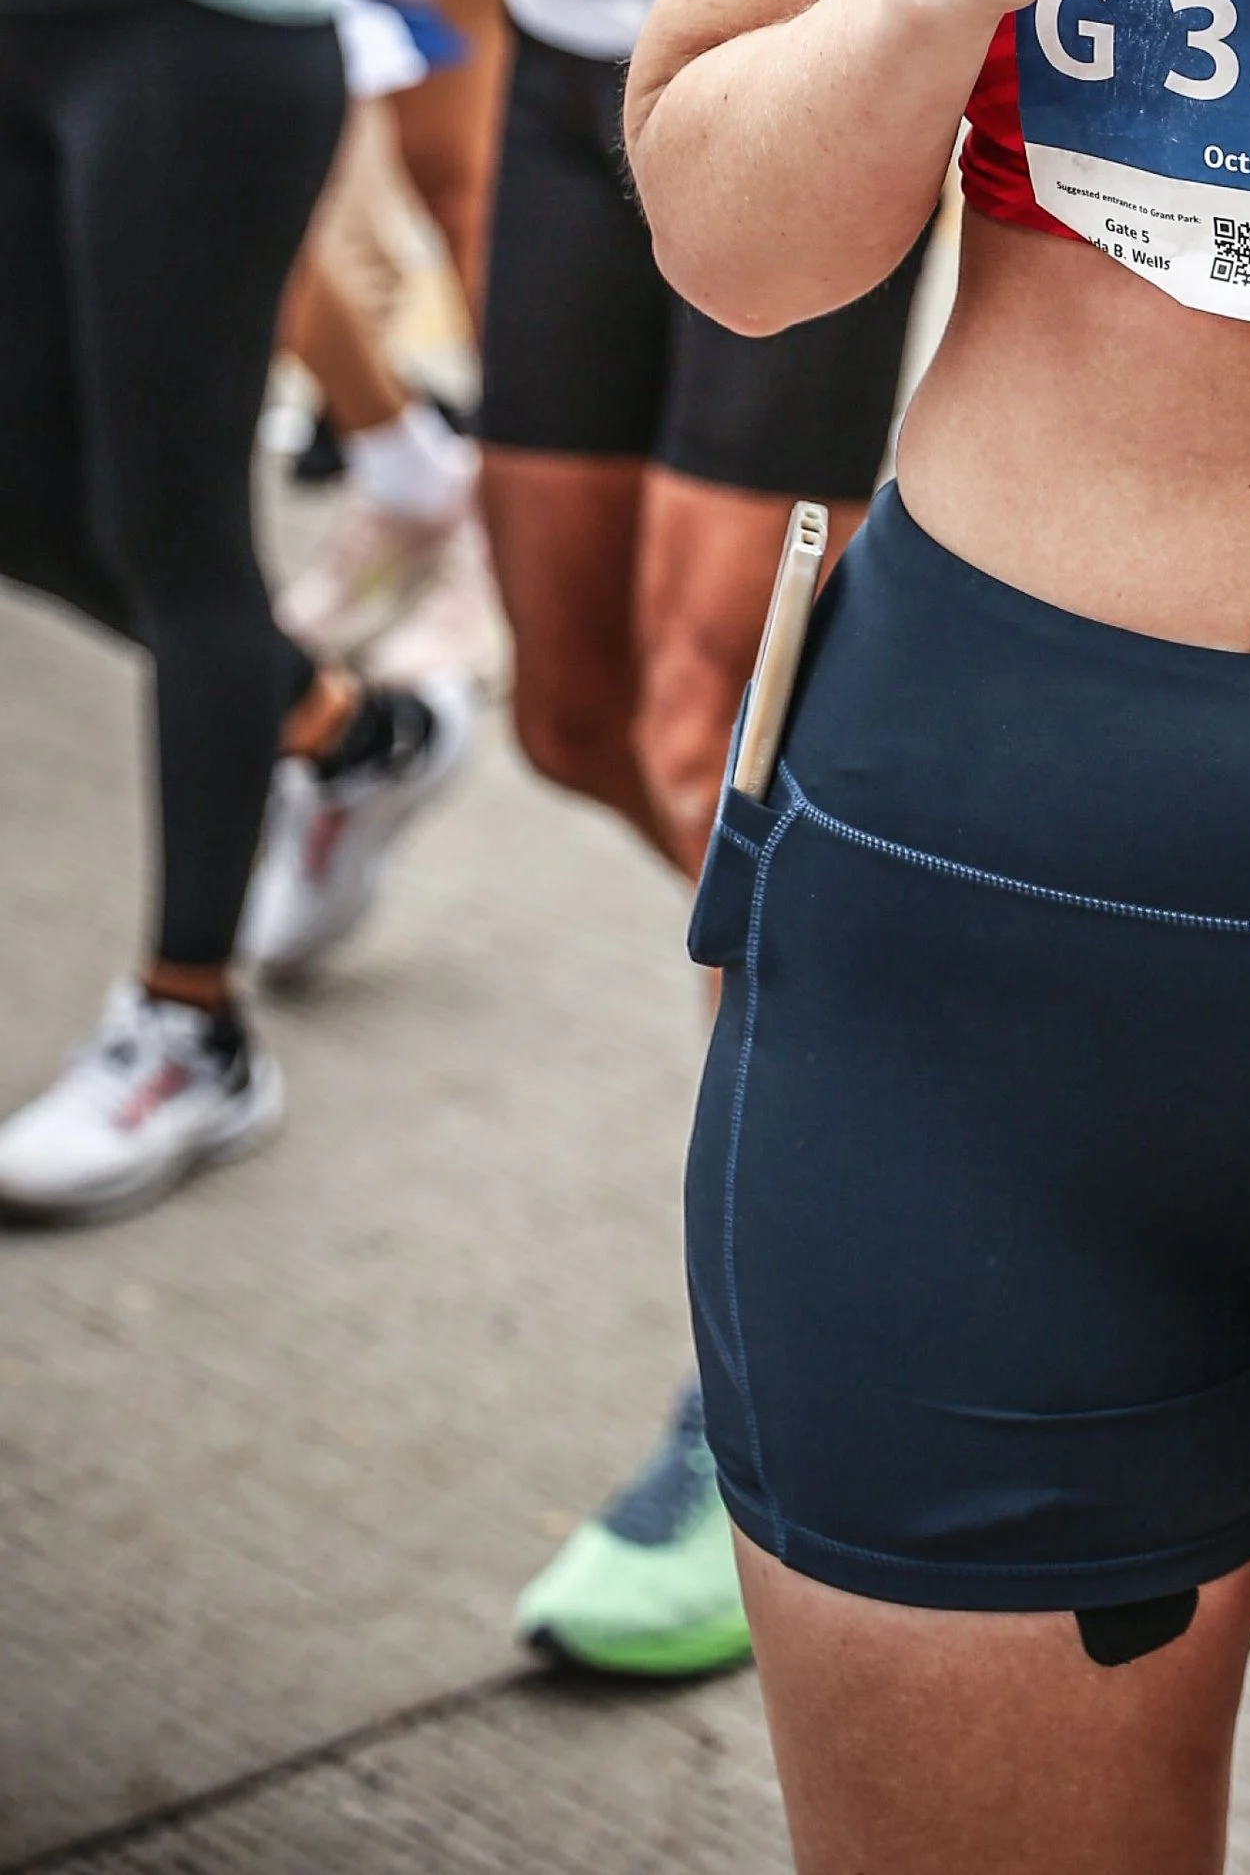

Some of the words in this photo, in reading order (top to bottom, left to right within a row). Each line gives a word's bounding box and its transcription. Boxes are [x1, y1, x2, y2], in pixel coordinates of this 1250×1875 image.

[1056, 181, 1100, 199] Suggested
[1102, 194, 1137, 211] entrance
[1139, 205, 1148, 214] to
[1150, 208, 1175, 222] Grant
[1105, 218, 1138, 240] Gate
[1141, 229, 1151, 244] 5
[1113, 243, 1127, 260] B.
[1132, 248, 1172, 270] Wells
